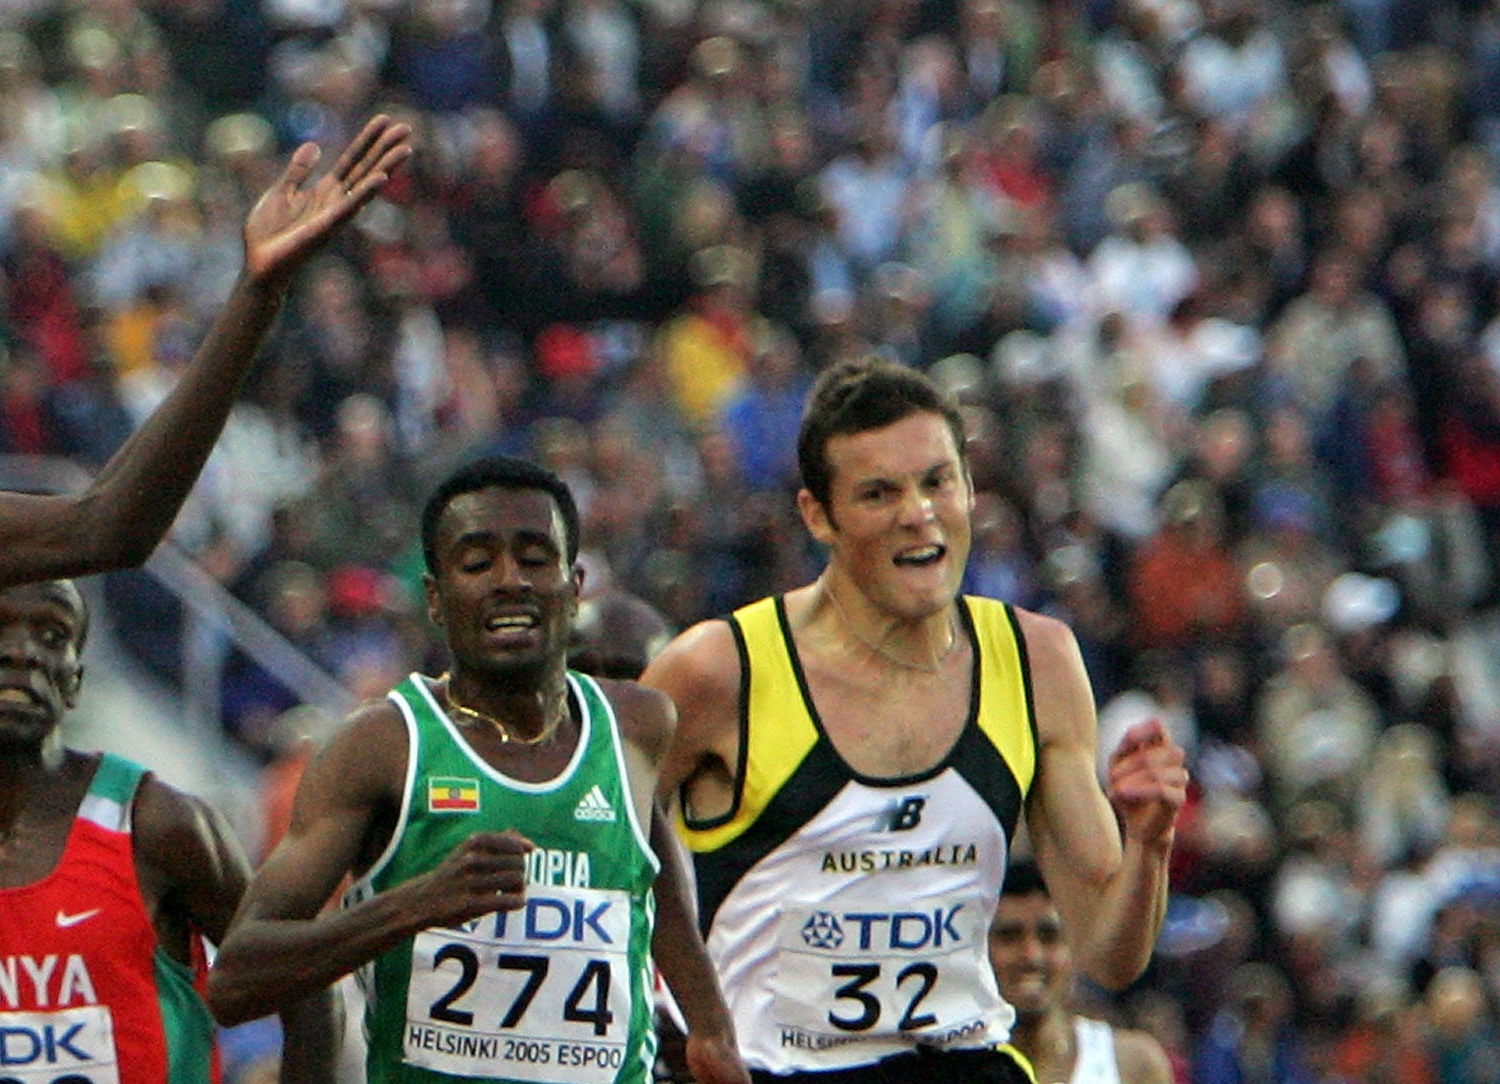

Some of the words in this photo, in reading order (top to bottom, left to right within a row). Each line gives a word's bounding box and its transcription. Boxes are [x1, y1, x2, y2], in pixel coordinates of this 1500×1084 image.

[524, 848, 591, 888] IOPIA
[821, 844, 978, 873] AUSTRALIA
[843, 904, 965, 949] TDK
[429, 943, 613, 1036] 274
[828, 962, 938, 1032] 32
[408, 1025, 499, 1059] HELSINKI
[504, 1040, 550, 1063] 2005
[557, 1045, 621, 1069] ESPOO
